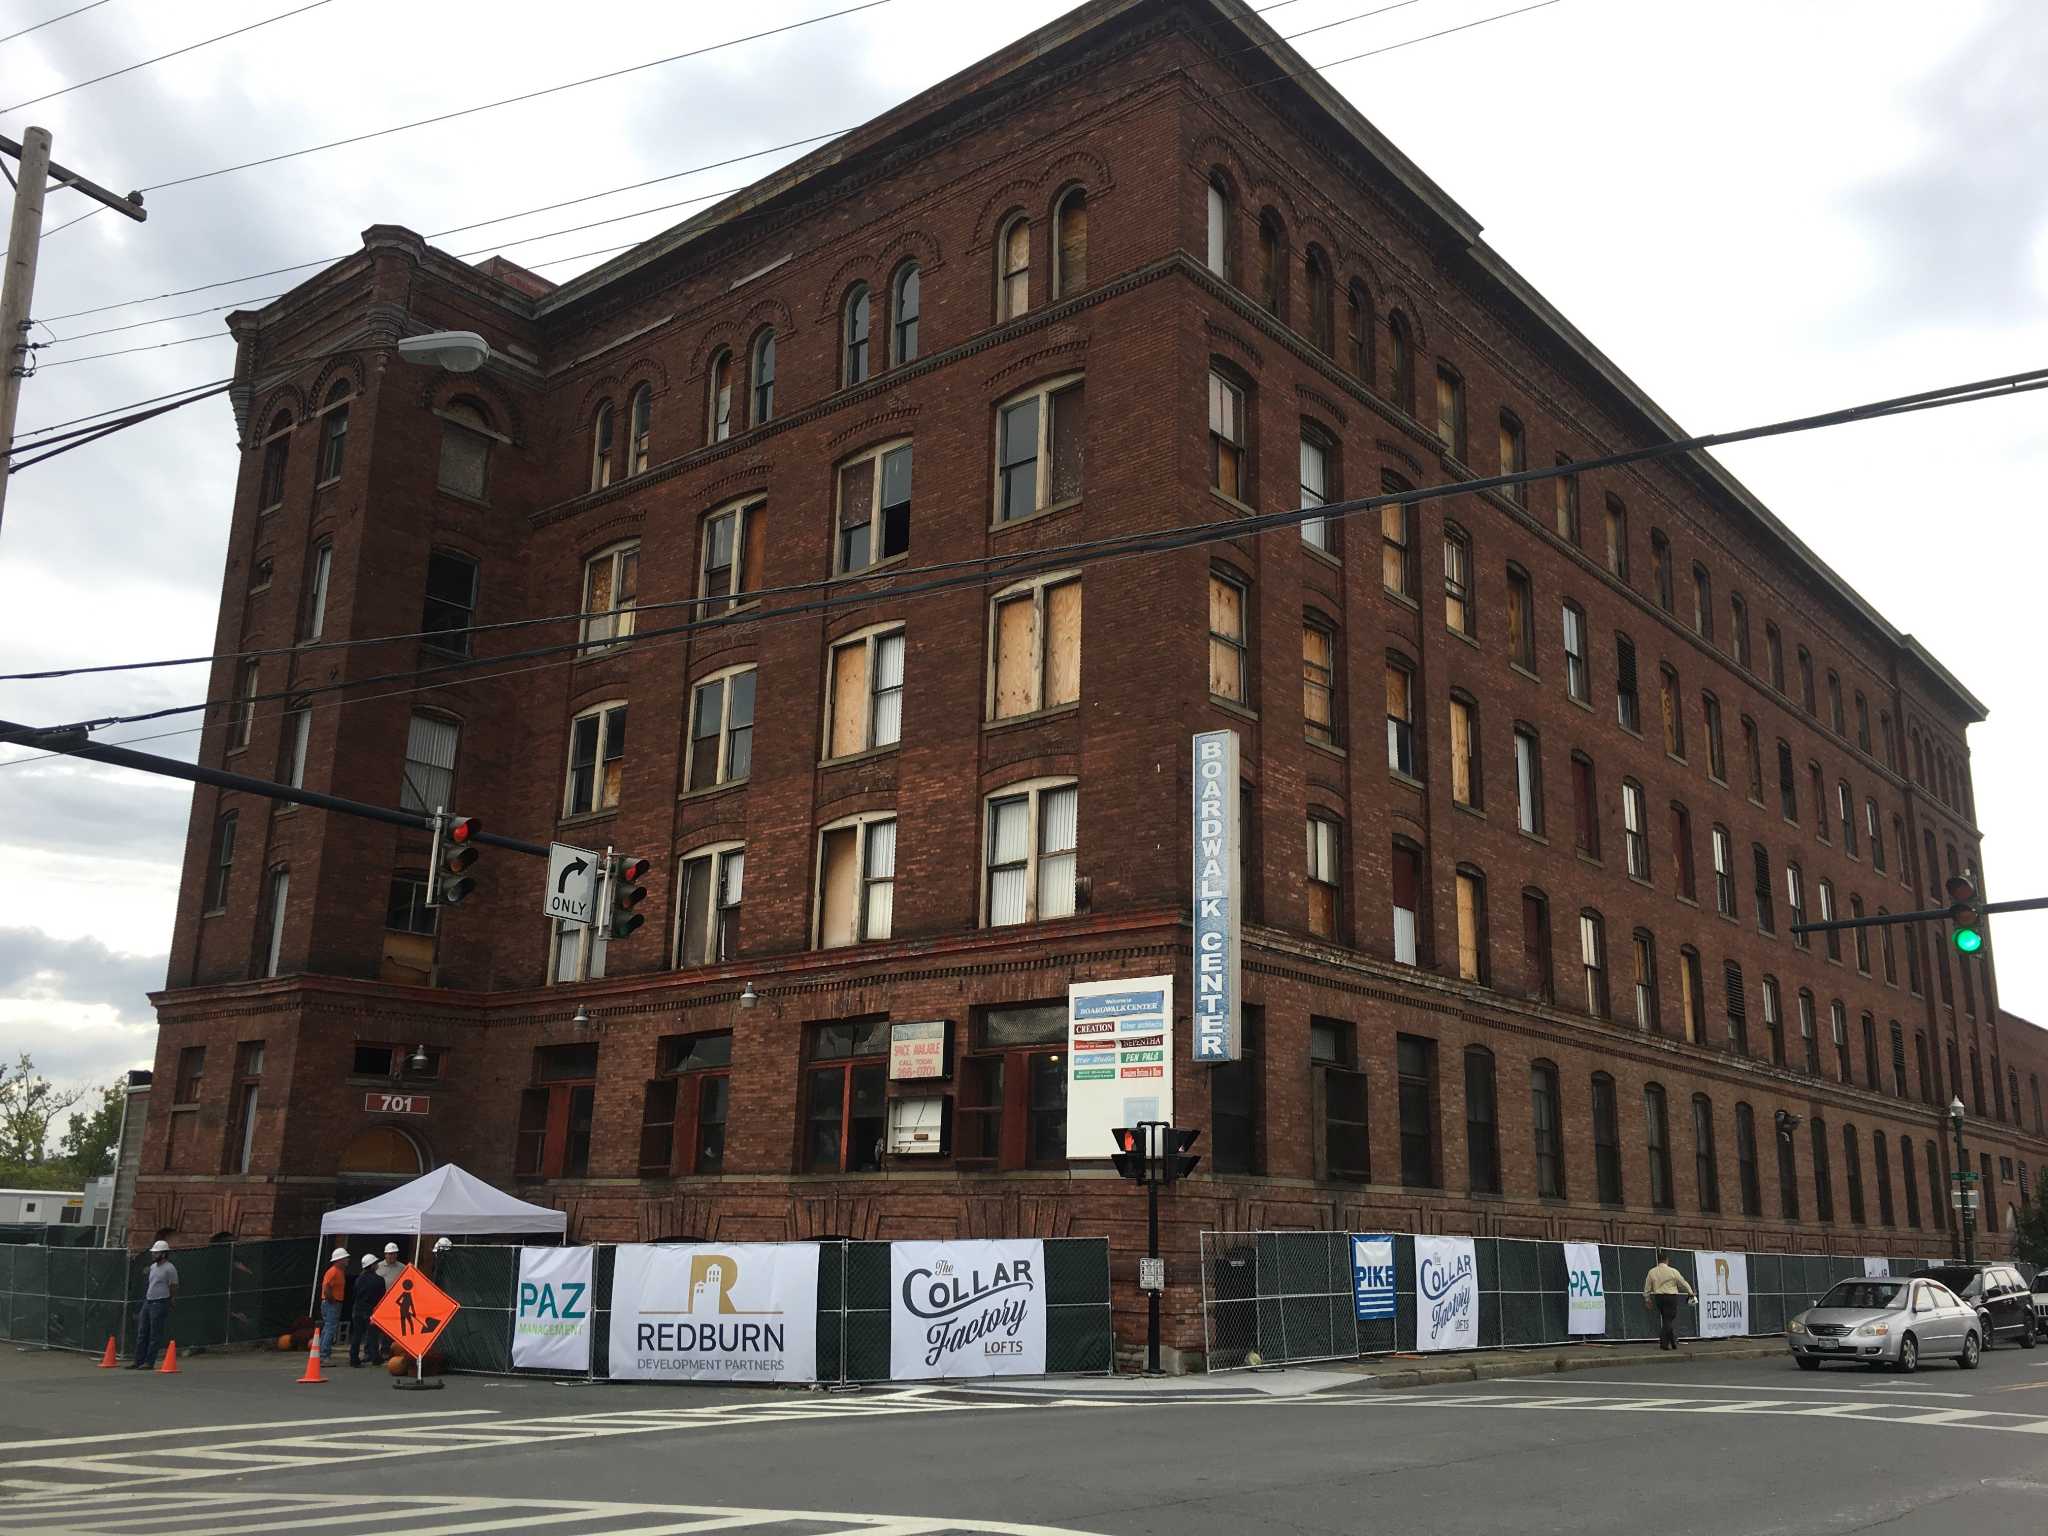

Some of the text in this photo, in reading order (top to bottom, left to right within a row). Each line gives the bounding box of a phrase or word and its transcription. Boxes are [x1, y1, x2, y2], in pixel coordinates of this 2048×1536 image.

[552, 897, 587, 916] ONLY
[1200, 741, 1224, 1056] BOARDWALK CENTER
[1080, 1003, 1158, 1015] BOARDWALK CENTER
[1076, 1023, 1113, 1034] CREATION
[381, 1095, 412, 1112] 701
[935, 1259, 953, 1275] The
[1358, 1265, 1393, 1287] PIKE
[1569, 1270, 1603, 1296] PAZ
[520, 1282, 586, 1319] PAZ
[518, 1322, 585, 1337] MANAGEMENT
[637, 1323, 785, 1352] REDBURN
[925, 1297, 1027, 1366] Factory
[984, 1340, 1023, 1354] LOFTS
[637, 1358, 785, 1371] DEVELOPMENT PARTNERS
